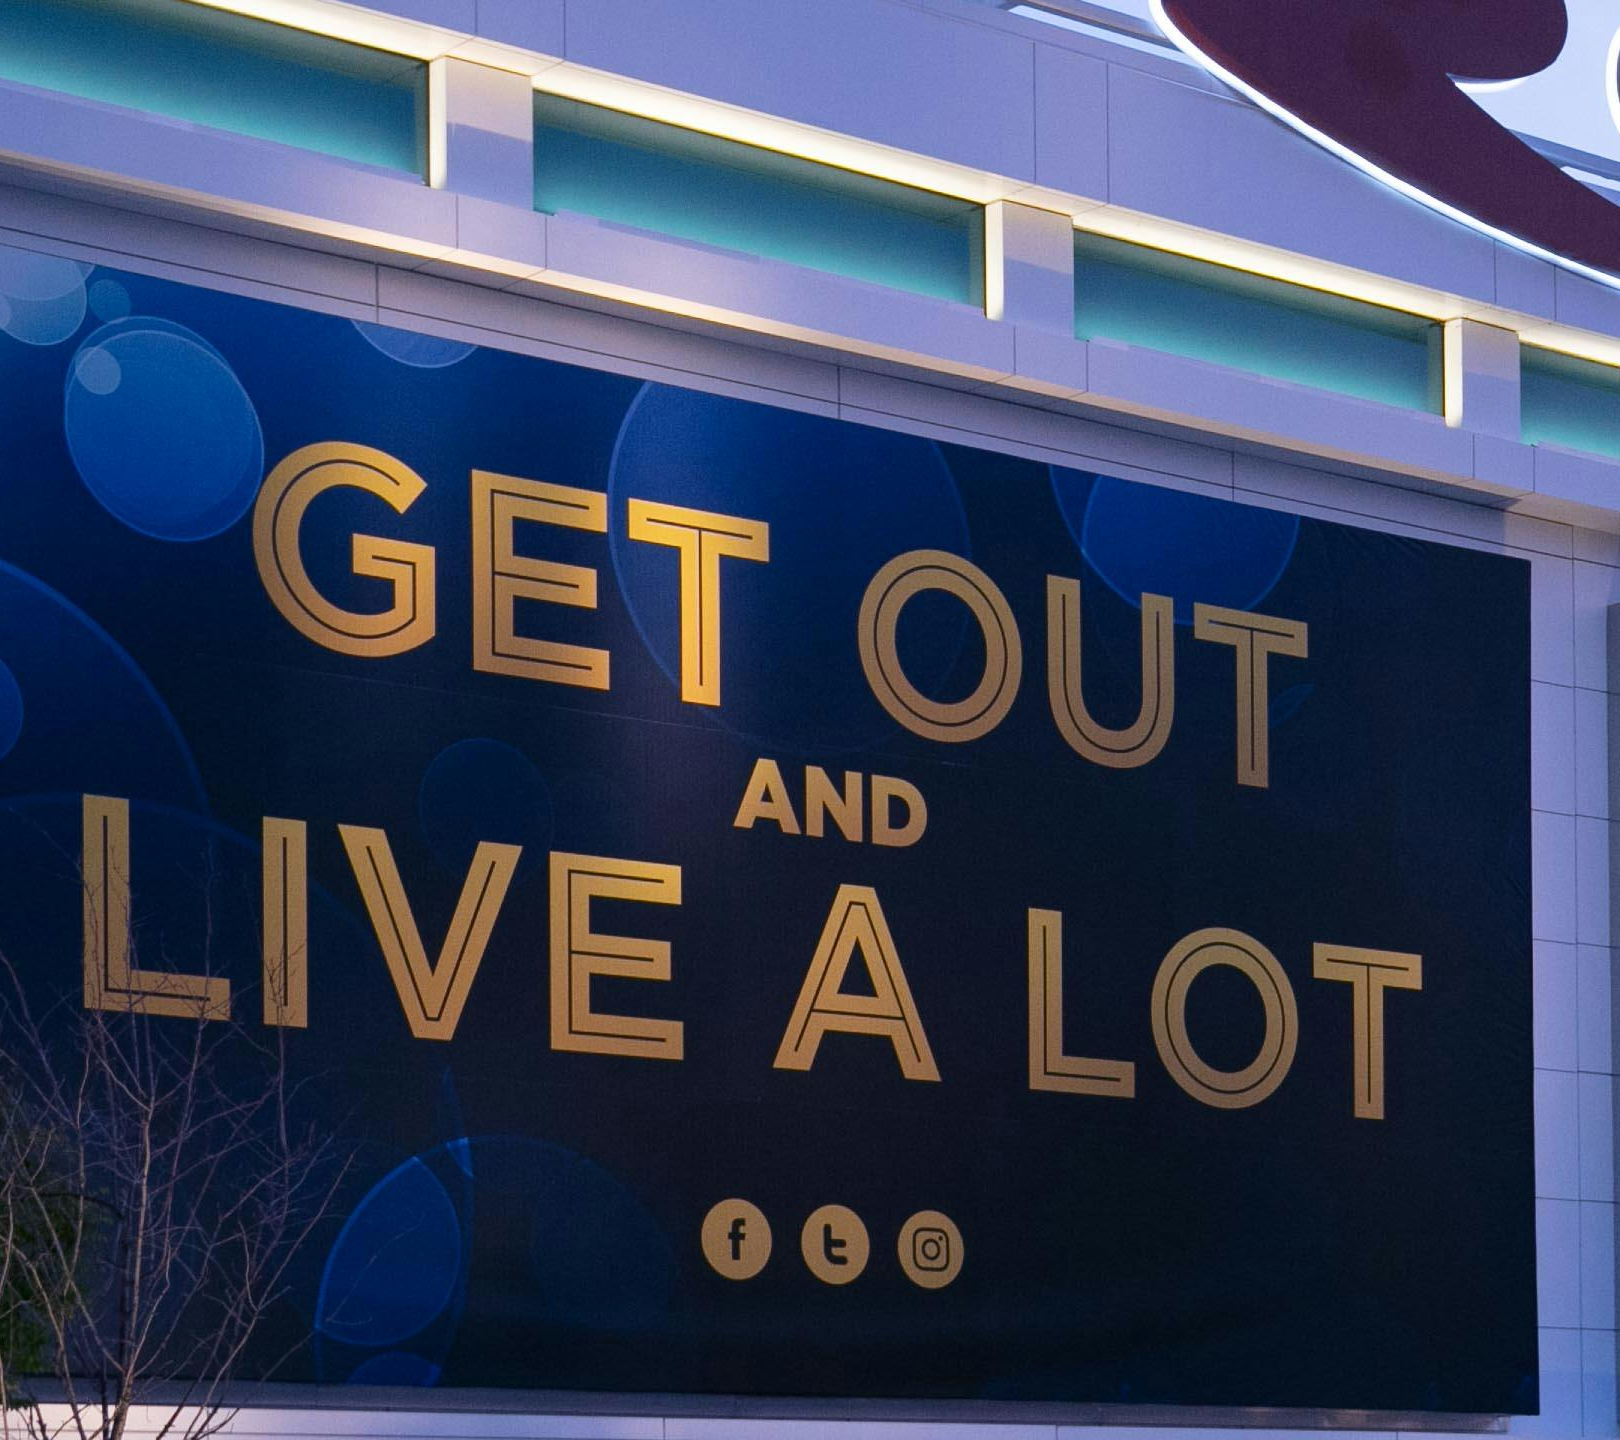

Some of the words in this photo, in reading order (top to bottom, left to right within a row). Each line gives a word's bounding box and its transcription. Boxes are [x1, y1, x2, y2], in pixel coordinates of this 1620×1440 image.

[253, 440, 769, 706] GET
[858, 549, 1308, 788] OUT
[82, 794, 684, 1061] LIVE
[773, 884, 941, 1081] A
[1028, 908, 1422, 1120] LOT
[732, 758, 928, 848] AND
